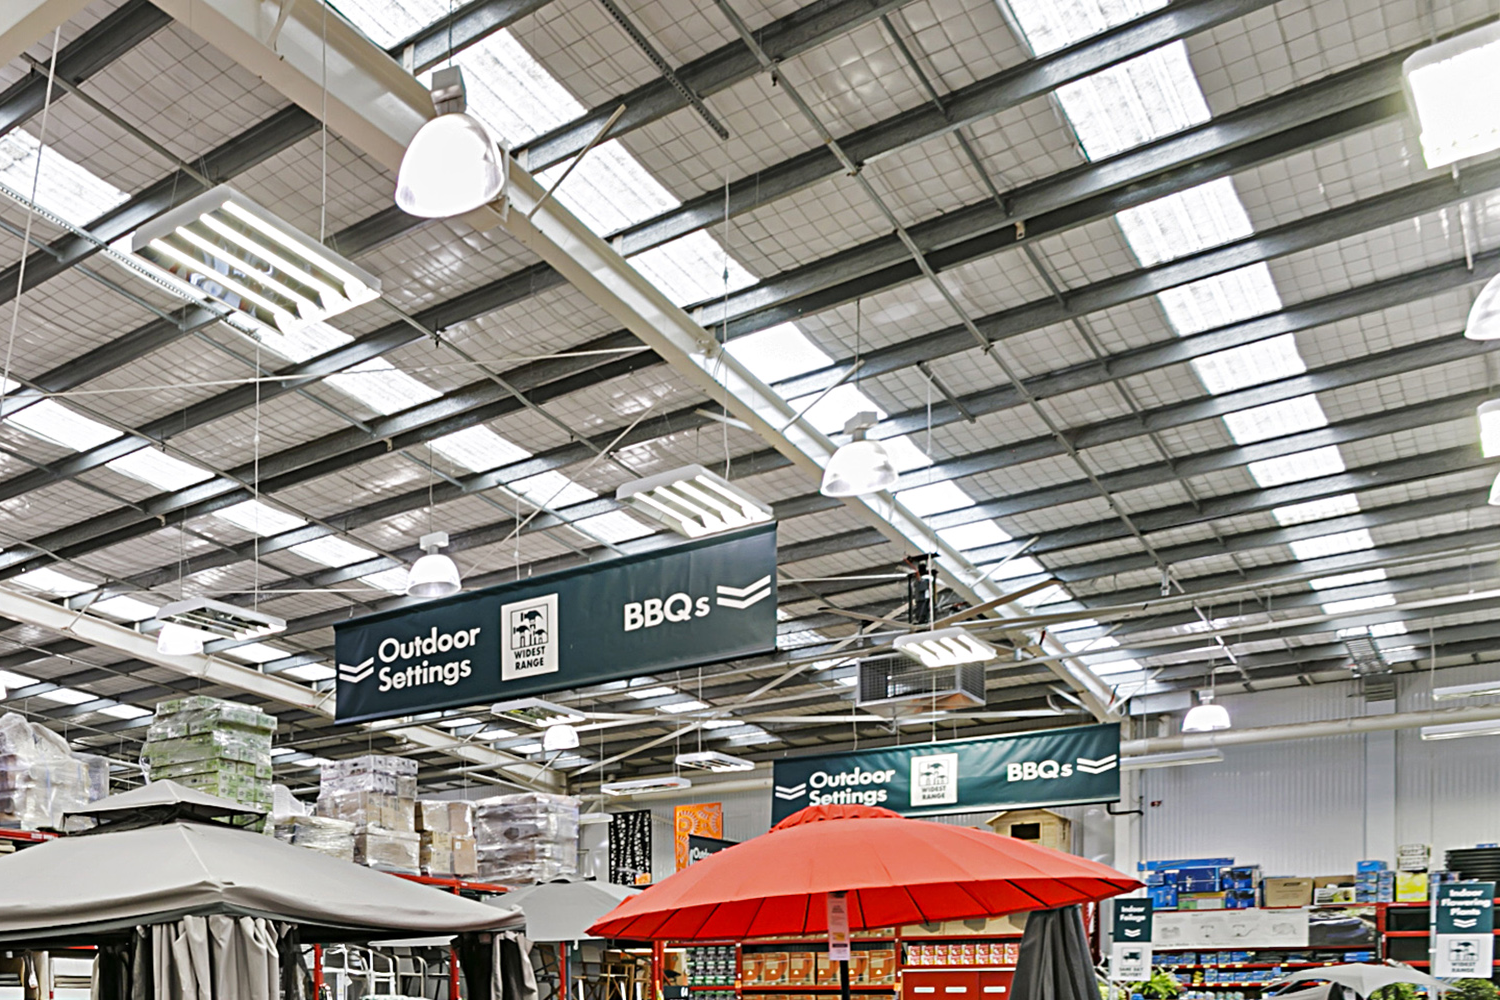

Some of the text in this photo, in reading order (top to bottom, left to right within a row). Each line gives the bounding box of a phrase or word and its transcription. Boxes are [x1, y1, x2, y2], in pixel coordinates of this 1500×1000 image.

[623, 592, 711, 634] BBQs
[378, 625, 482, 664] Outdoor
[513, 645, 548, 664] WIDEST
[514, 656, 546, 673] RANGE
[378, 656, 473, 694] Settings
[809, 766, 896, 792] Outdoor
[1006, 760, 1074, 784] BBQs
[809, 784, 890, 807] Settings
[920, 785, 948, 798] WIDEST
[921, 794, 947, 806] RANGE
[1449, 889, 1485, 898] Indoor
[1441, 899, 1491, 909] Flowering
[1450, 908, 1482, 917] Plants
